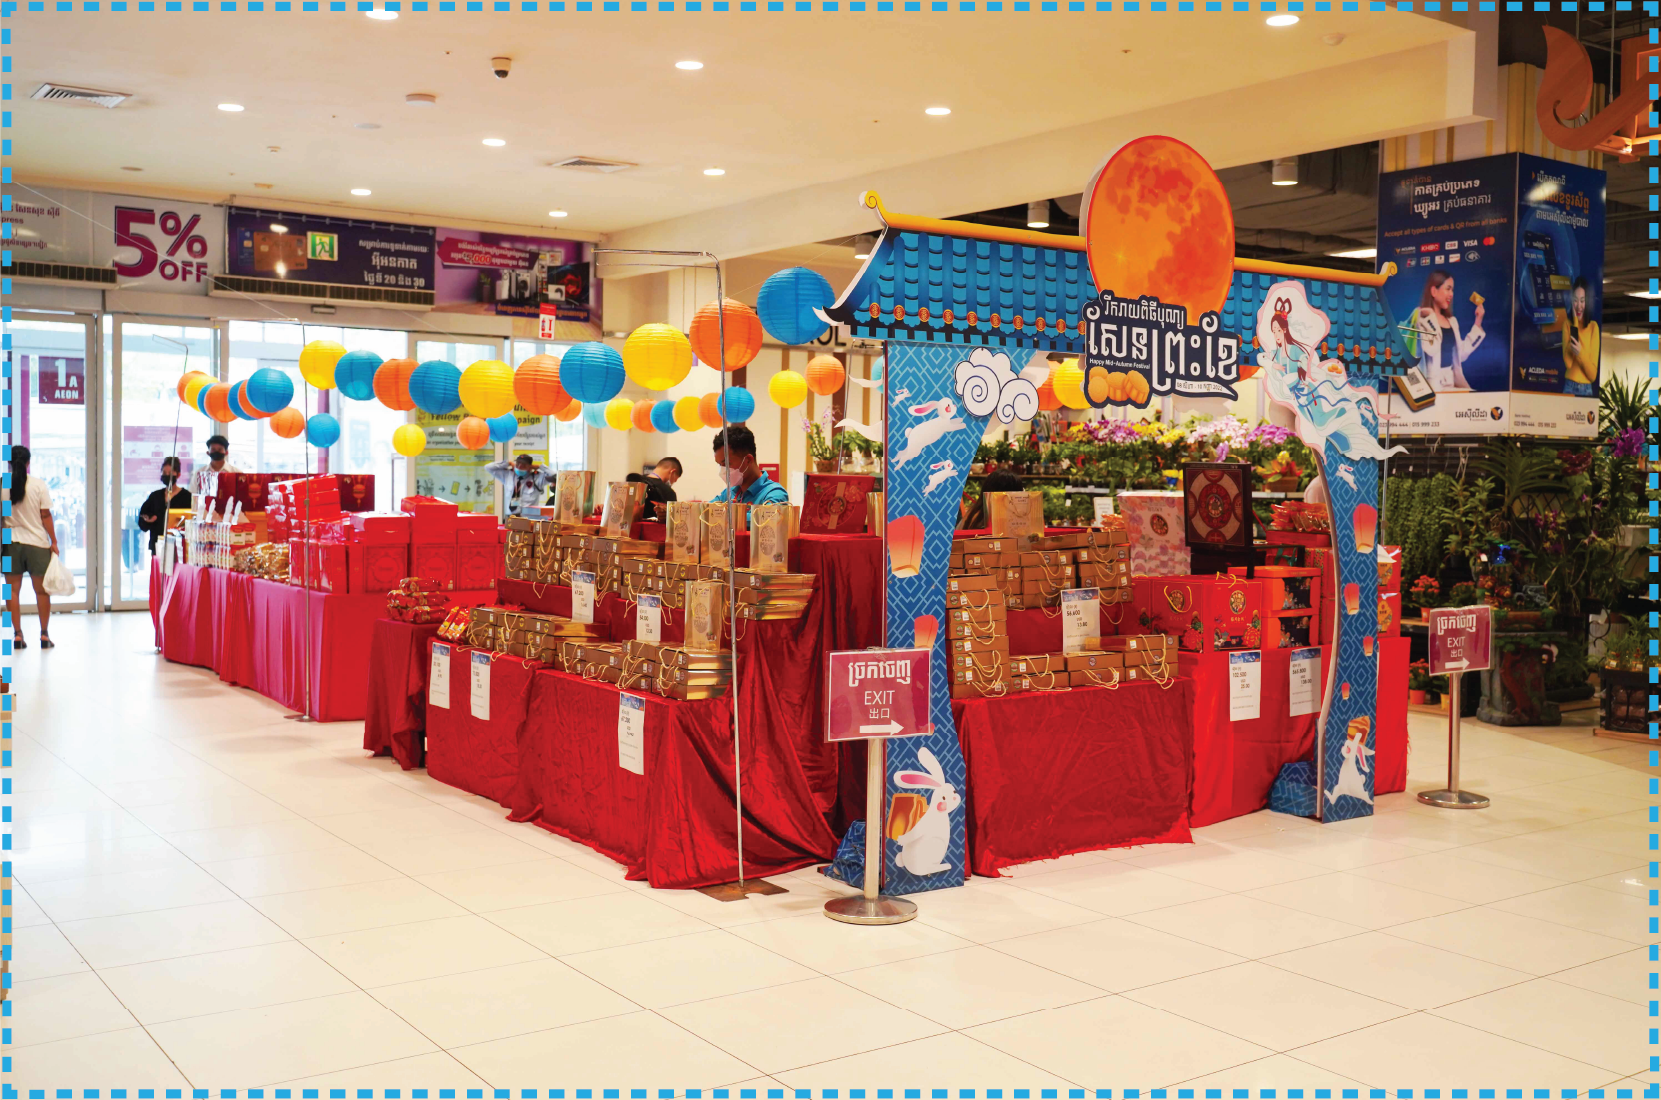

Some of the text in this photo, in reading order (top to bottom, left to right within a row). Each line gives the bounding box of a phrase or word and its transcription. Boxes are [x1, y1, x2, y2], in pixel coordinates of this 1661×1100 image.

[1414, 179, 1480, 197] កាតគ្រប់ប្រភេទ
[1443, 194, 1492, 213] គ្រប់ធនាគារ
[1434, 224, 1450, 232] cards
[1489, 217, 1507, 225] banks
[113, 205, 208, 278] 5%
[159, 259, 208, 283] OFF
[384, 274, 397, 285] 20
[413, 277, 426, 289] 30
[1104, 294, 1185, 330] រីករាយពិធីបុណ្យ
[1086, 305, 1239, 392] សែនព្រះខែ
[1089, 358, 1151, 370] Happy Mid-Autumn Festival
[54, 389, 79, 399] AEON
[1436, 614, 1477, 635] ច្រកចេញ
[1447, 637, 1466, 648] EXIT
[1450, 648, 1463, 658] 出口
[848, 659, 911, 687] ច្រកចេញ
[864, 690, 895, 705] EXIT
[869, 707, 890, 719] 出口
